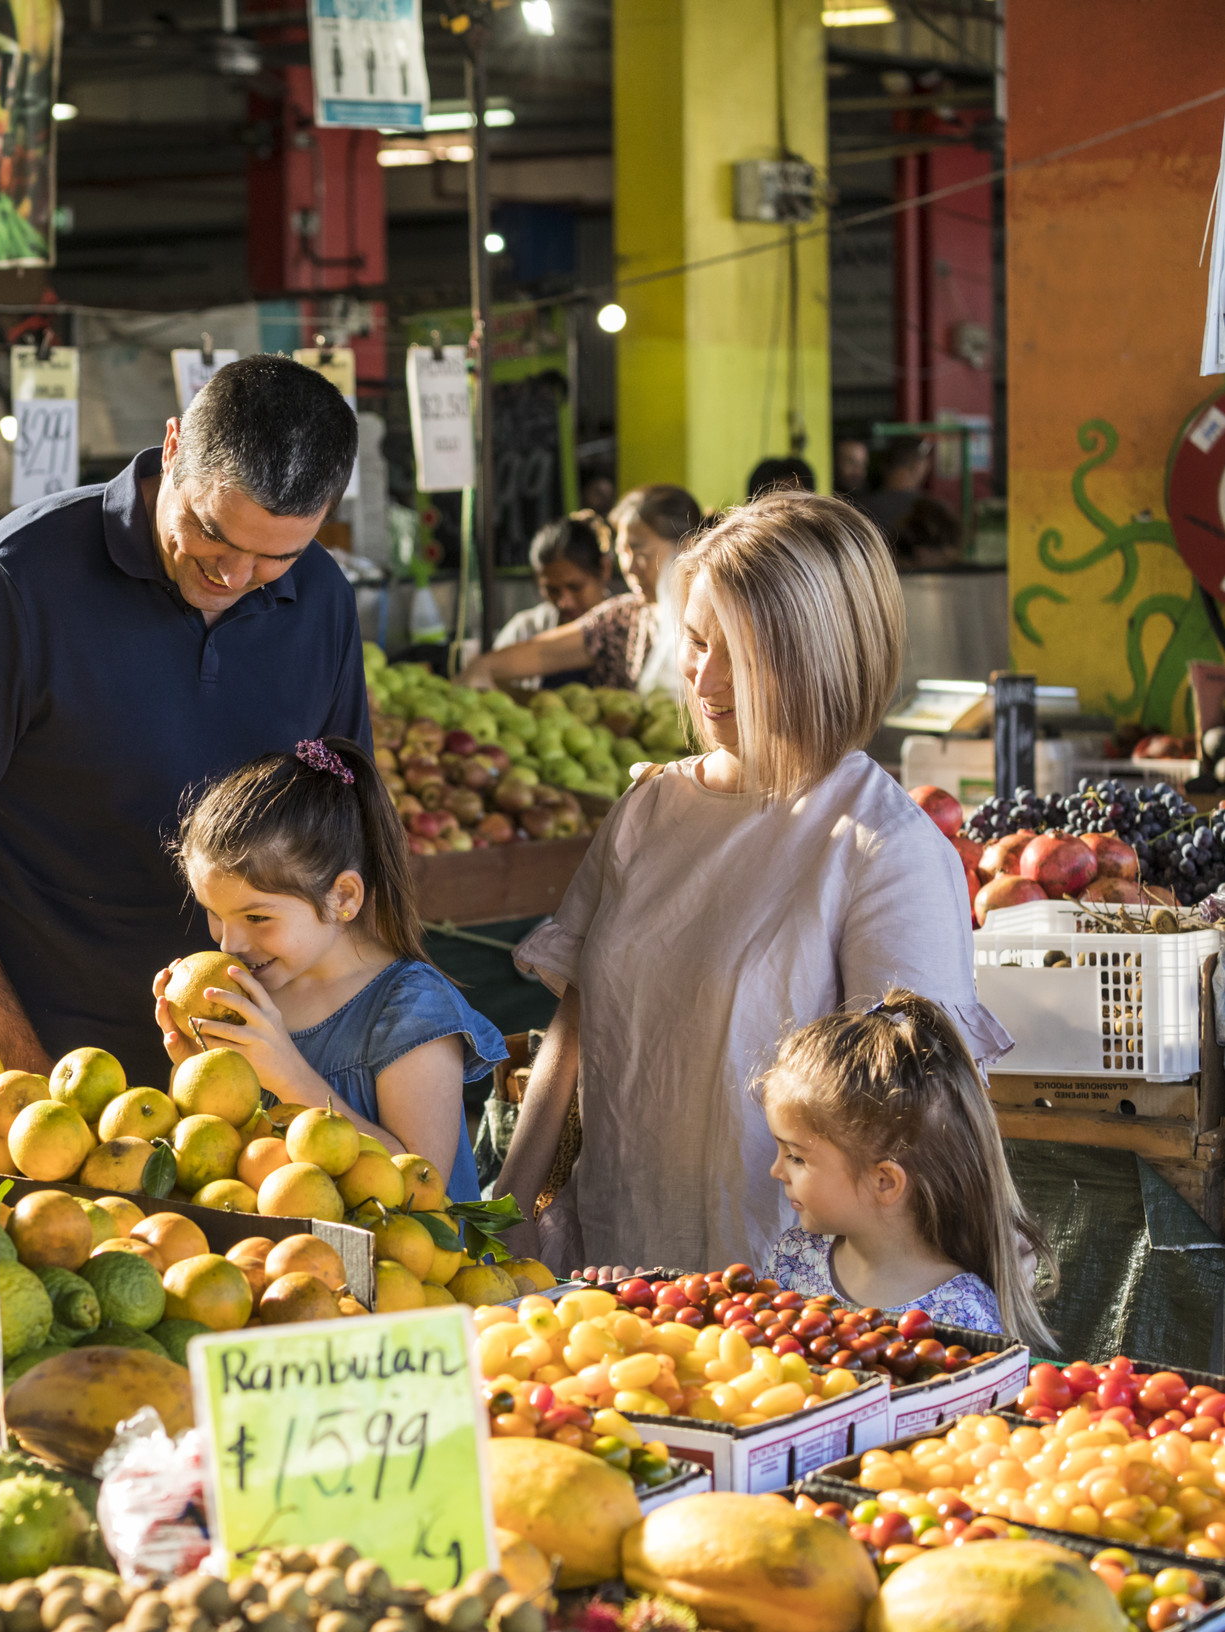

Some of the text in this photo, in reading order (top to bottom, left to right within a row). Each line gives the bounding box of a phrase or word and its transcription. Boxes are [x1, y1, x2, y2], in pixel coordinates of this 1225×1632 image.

[1033, 1081, 1129, 1091] GLASSHOUSE PRODUCE
[1054, 1091, 1090, 1099] RIPENED
[220, 1334, 467, 1394] Rambutan
